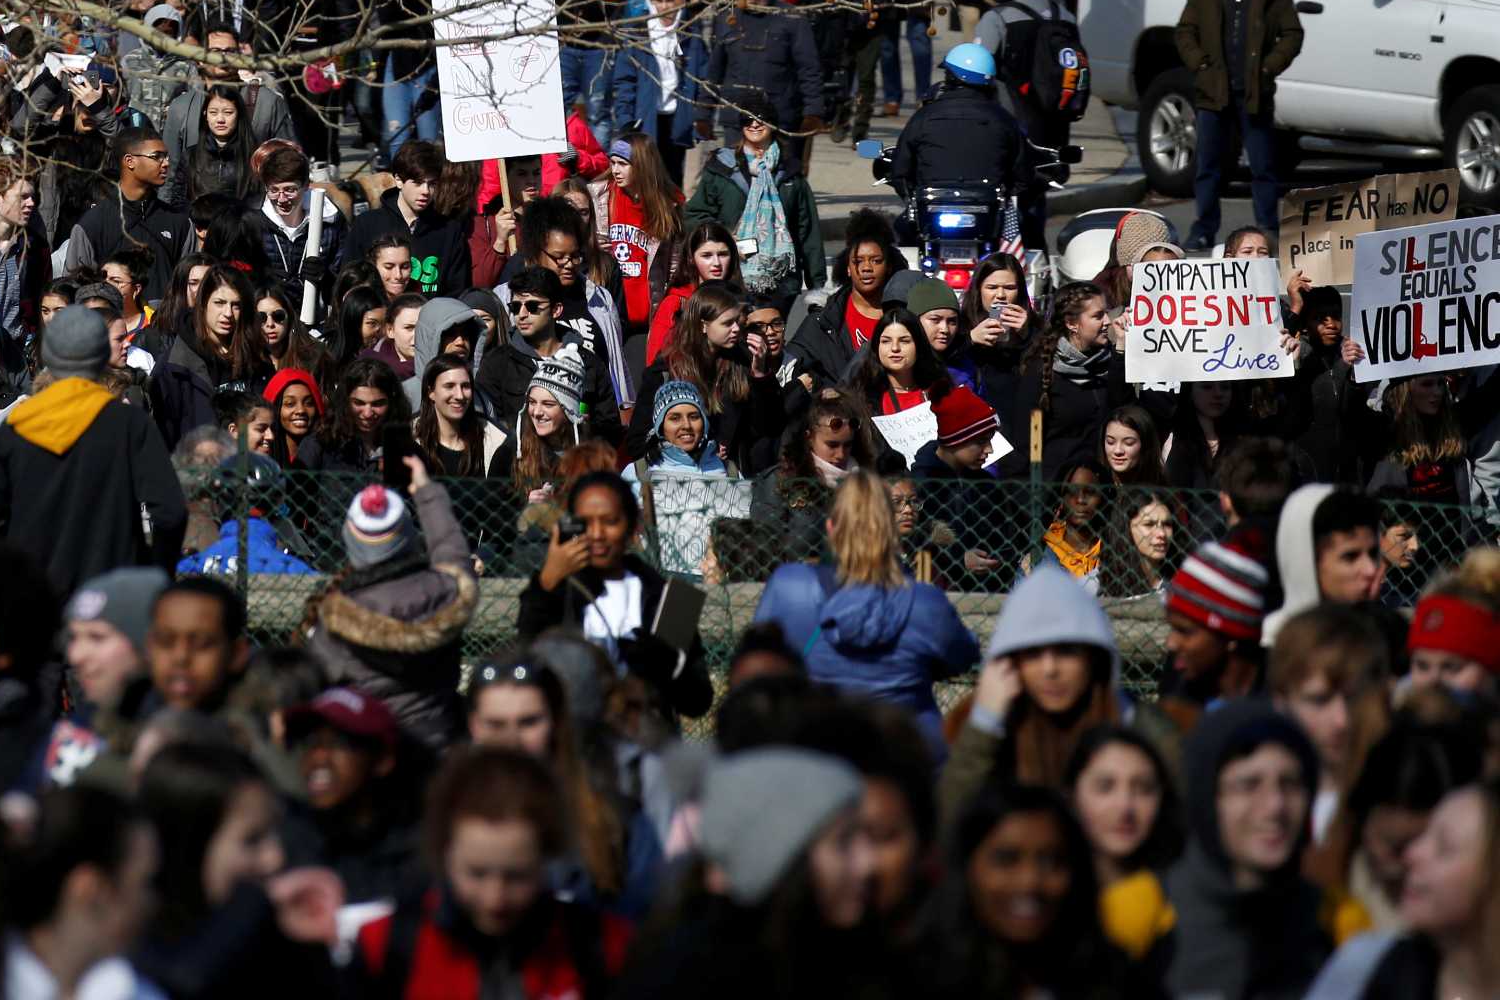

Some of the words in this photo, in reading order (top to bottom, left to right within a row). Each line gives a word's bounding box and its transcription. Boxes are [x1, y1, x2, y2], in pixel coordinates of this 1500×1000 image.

[1302, 189, 1380, 227] FEAR
[1386, 193, 1408, 217] has
[1413, 183, 1449, 215] NO
[1290, 231, 1331, 269] place
[1340, 235, 1354, 250] in
[1142, 261, 1250, 293] SYMPATHY
[1400, 264, 1477, 302] EQUALS
[1133, 294, 1276, 327] DOESN'T
[1143, 328, 1209, 353] SAVE
[1202, 333, 1280, 372] Lives
